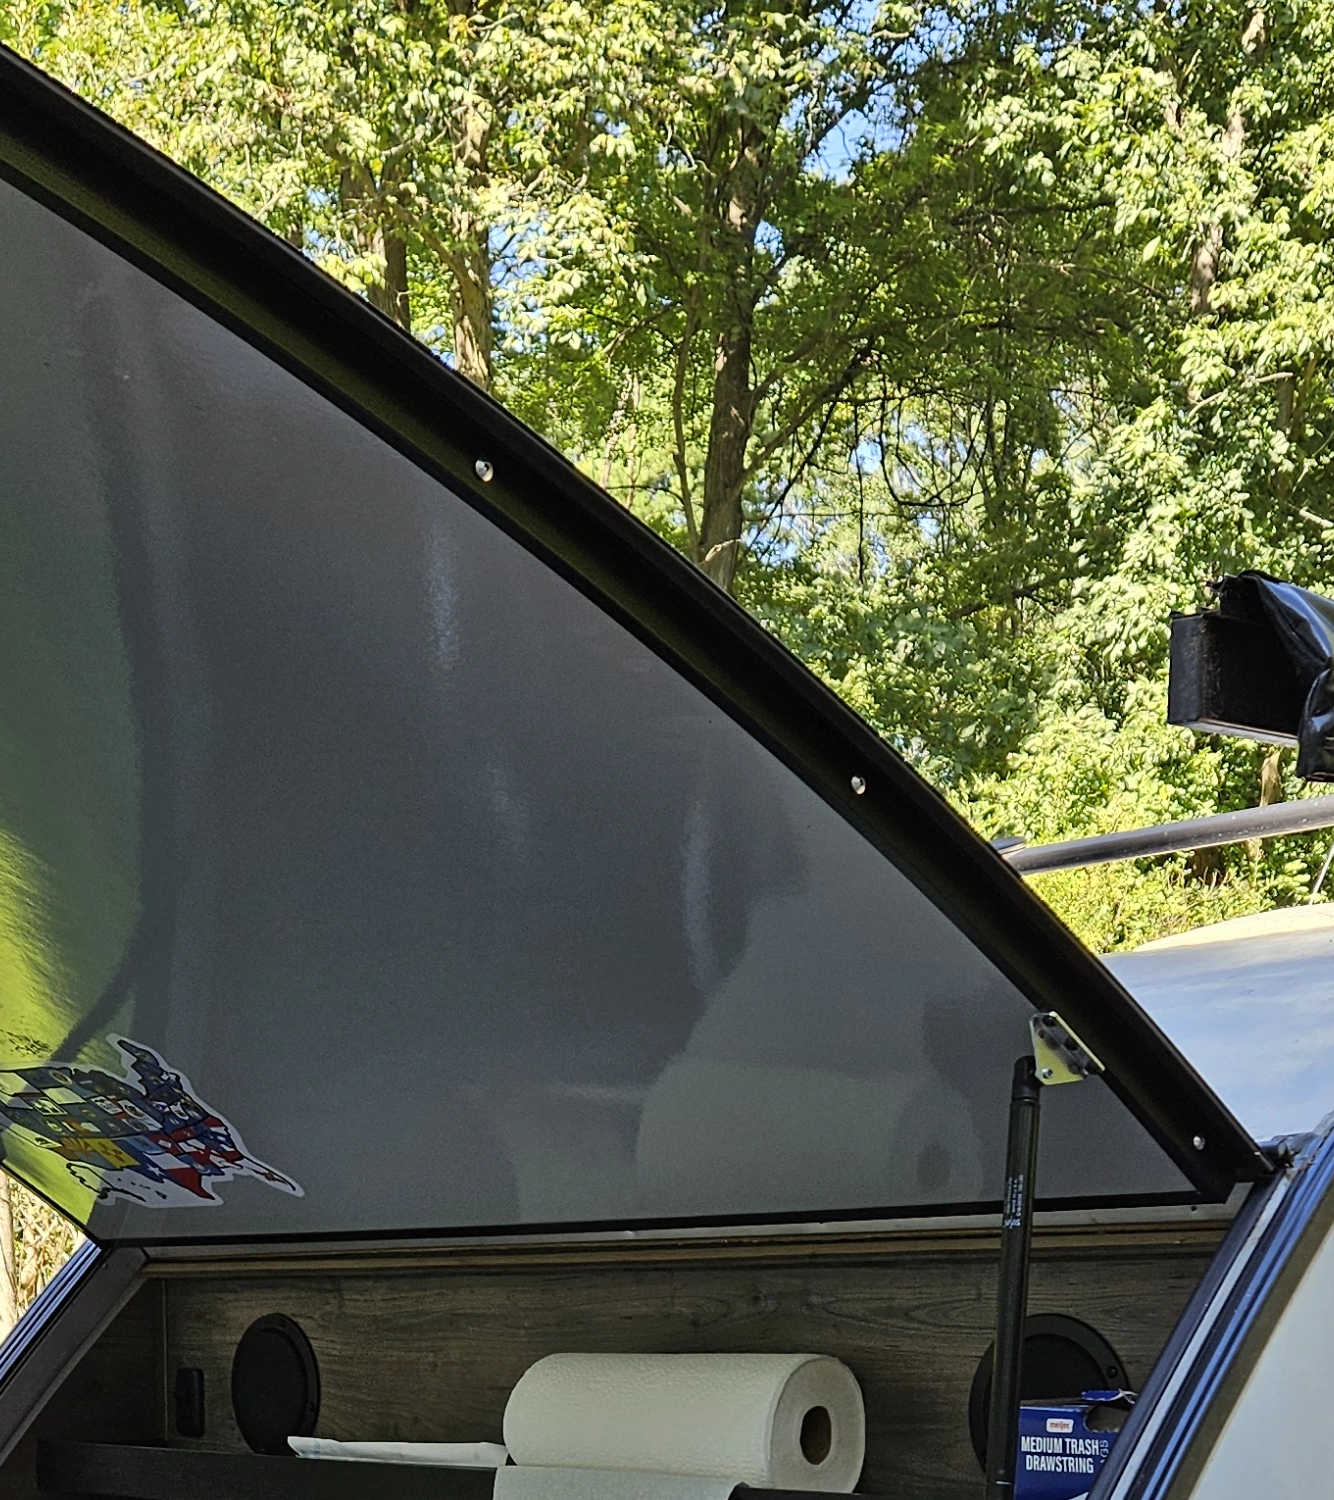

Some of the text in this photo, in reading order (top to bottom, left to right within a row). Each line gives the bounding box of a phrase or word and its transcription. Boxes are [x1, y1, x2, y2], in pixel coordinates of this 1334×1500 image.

[1021, 1436, 1099, 1456] MEDIUM TRASH
[1026, 1454, 1094, 1474] DRAWSTRING
